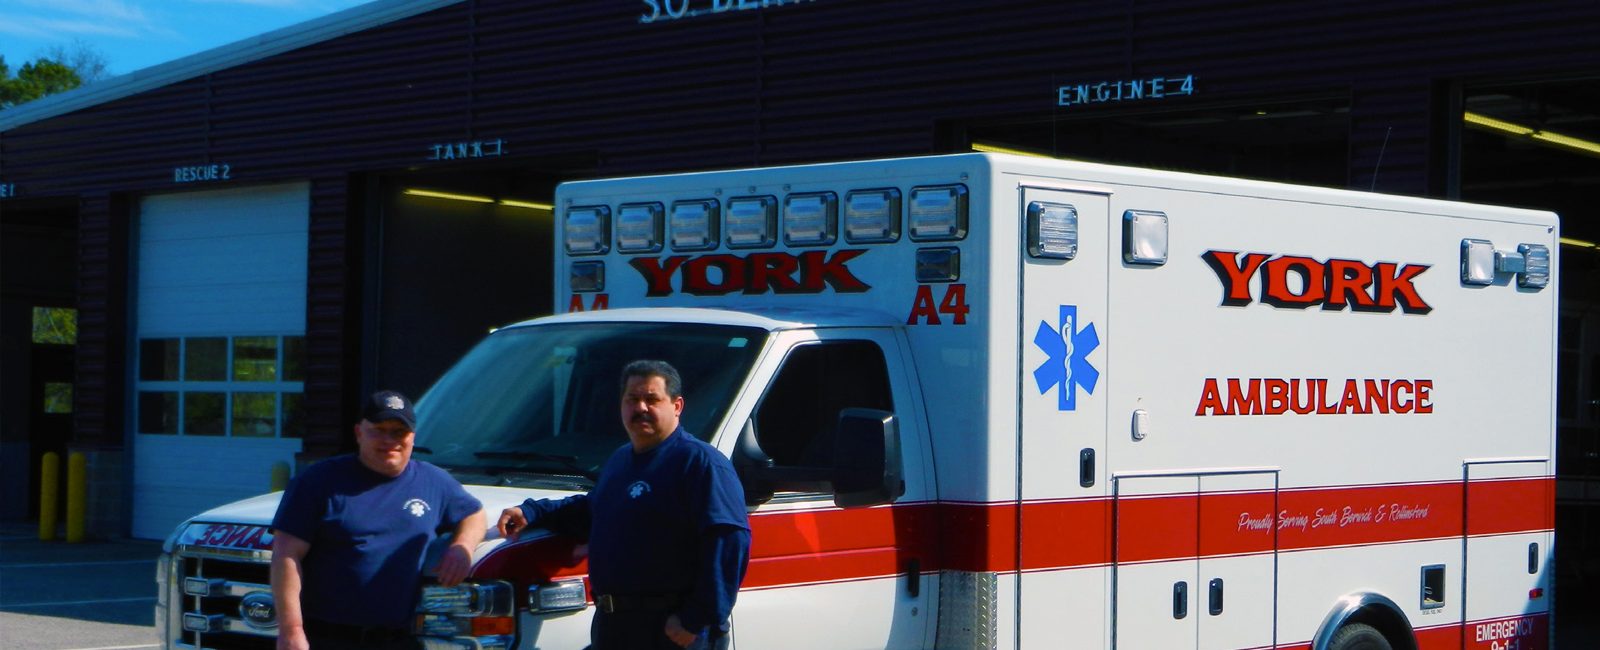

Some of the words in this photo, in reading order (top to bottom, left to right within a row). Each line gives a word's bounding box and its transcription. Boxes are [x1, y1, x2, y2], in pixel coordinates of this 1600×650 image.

[1058, 78, 1165, 106] ENGINE
[1180, 74, 1195, 96] 4
[432, 142, 483, 162] TANK
[175, 165, 218, 183] RESCUE
[223, 164, 231, 180] 2
[628, 248, 872, 297] YORK
[1200, 248, 1435, 316] YORK
[907, 283, 970, 327] A4
[1195, 377, 1434, 416] AMBULANCE
[1238, 512, 1273, 534] Proudly
[1277, 509, 1309, 533] Serving
[1312, 508, 1338, 529] South
[1375, 504, 1387, 523] &
[248, 602, 271, 618] Ford
[1476, 616, 1535, 642] EMERGENCY
